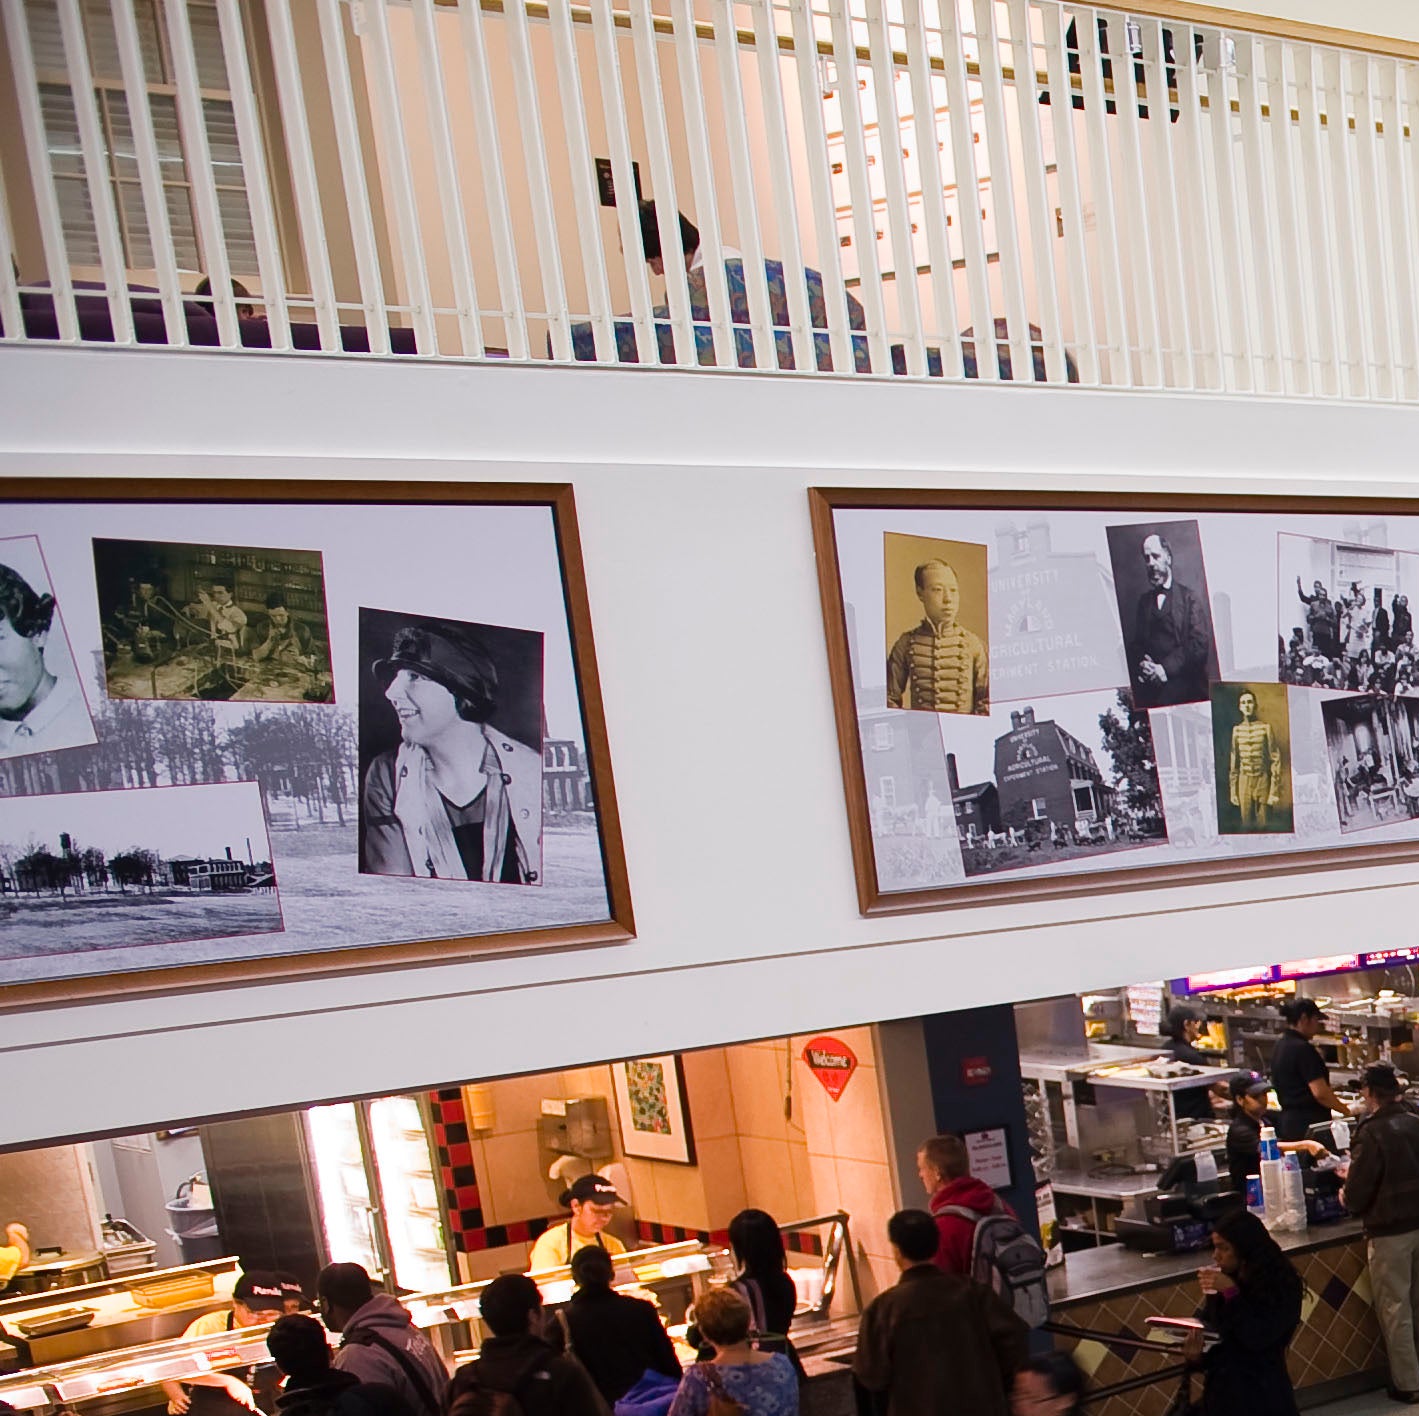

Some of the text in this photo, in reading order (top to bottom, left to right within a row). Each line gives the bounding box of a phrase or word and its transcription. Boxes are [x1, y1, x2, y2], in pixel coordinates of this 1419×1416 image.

[990, 633, 1082, 659] GRICULTURAL
[810, 1049, 848, 1068] Welcome
[252, 1285, 282, 1296] Panda
